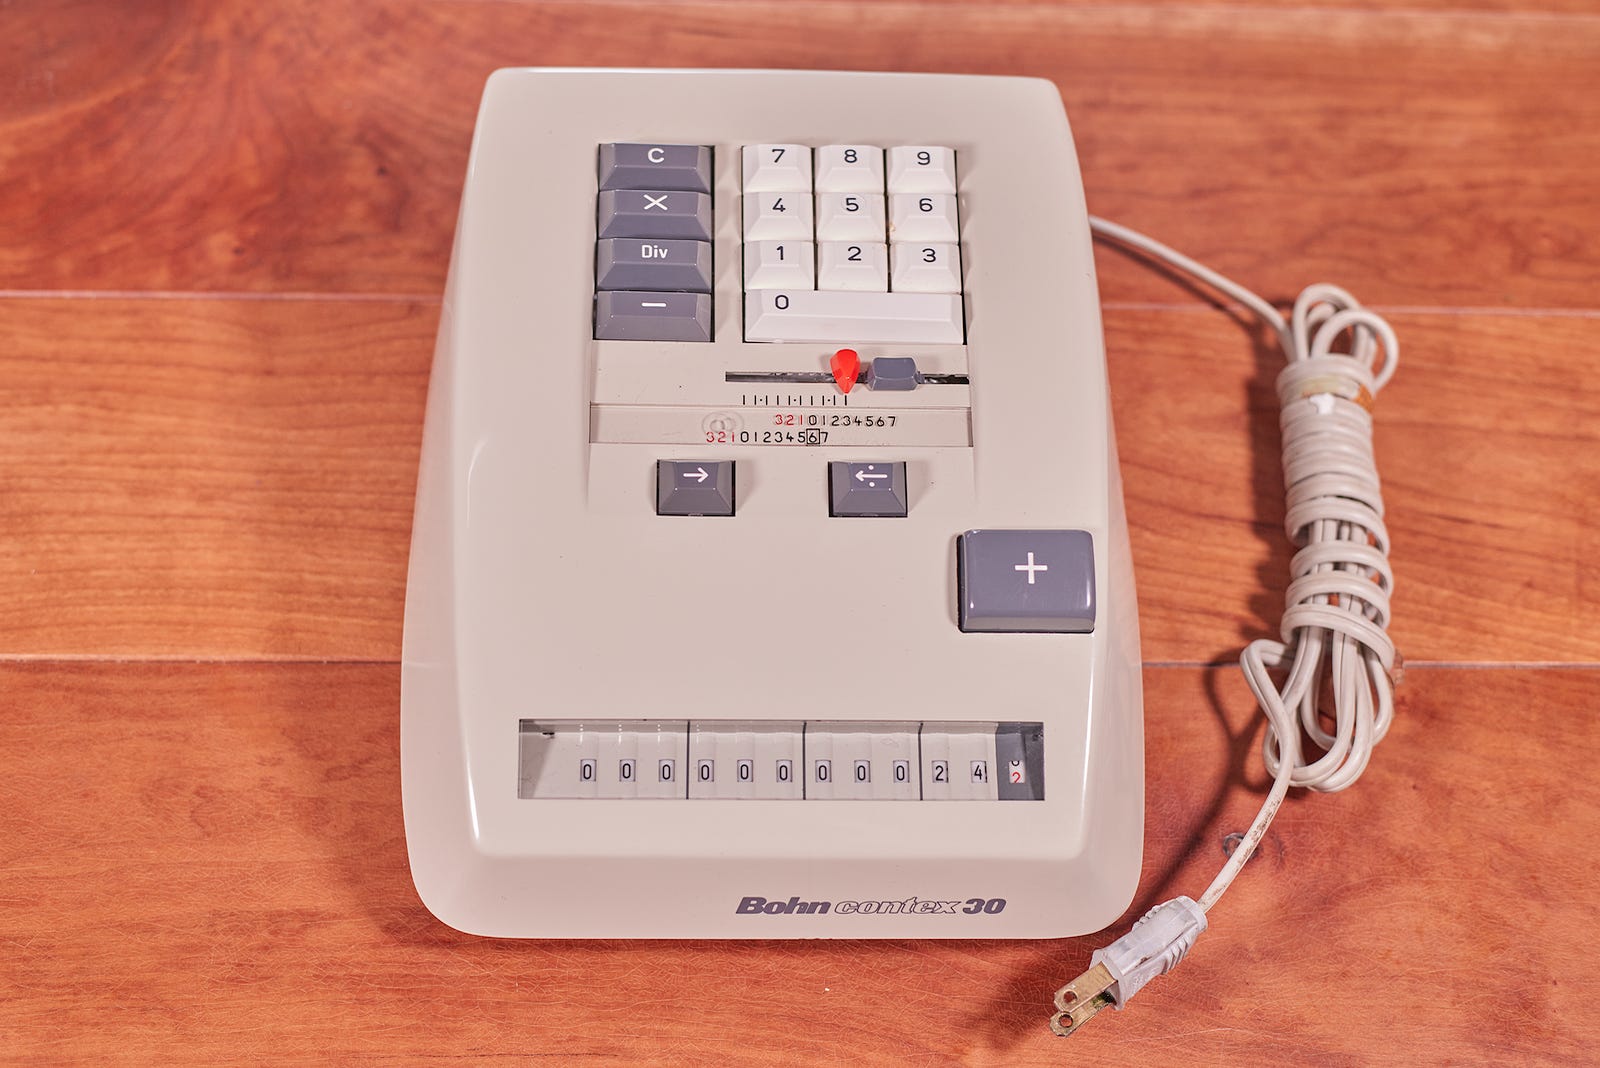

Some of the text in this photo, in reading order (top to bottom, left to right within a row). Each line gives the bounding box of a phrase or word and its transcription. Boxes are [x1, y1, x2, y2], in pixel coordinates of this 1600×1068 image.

[647, 147, 665, 164] C
[771, 148, 786, 164] 7
[843, 148, 859, 164] 8
[916, 150, 931, 166] 9
[771, 197, 786, 213] 4
[845, 197, 860, 213] 5
[918, 197, 934, 213] 6
[641, 244, 668, 260] Div
[776, 245, 785, 261] 1
[847, 245, 862, 262] 2
[921, 247, 937, 263] 3
[774, 294, 790, 310] 0
[735, 896, 1006, 915] Bohn contex 30
